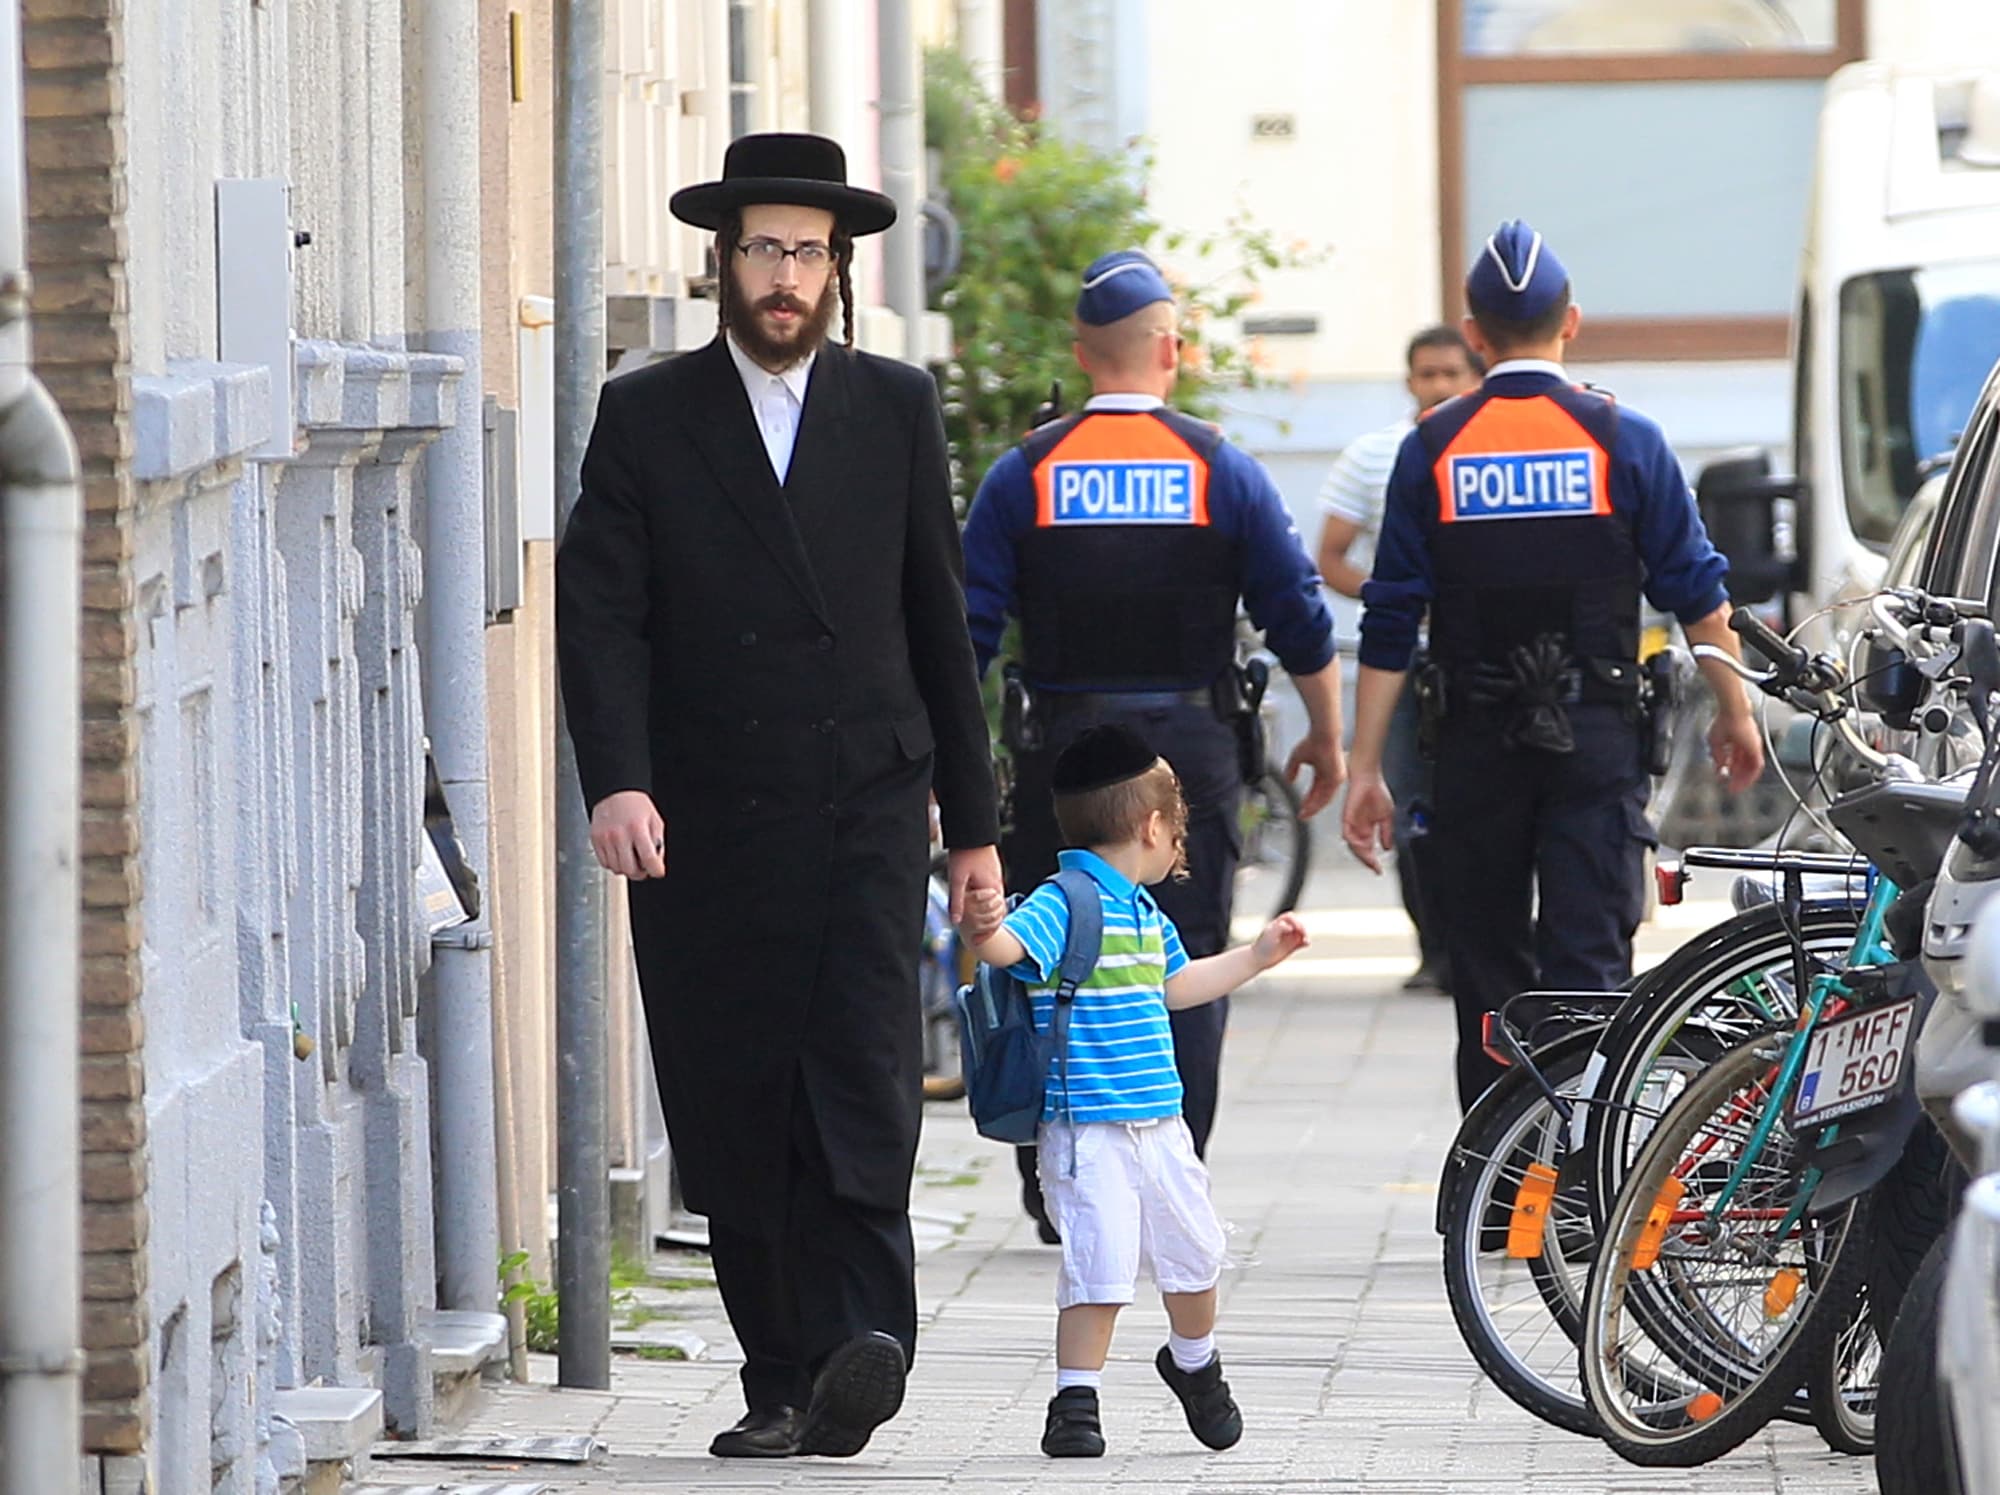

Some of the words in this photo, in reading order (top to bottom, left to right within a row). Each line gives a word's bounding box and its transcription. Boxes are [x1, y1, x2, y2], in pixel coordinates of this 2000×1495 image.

[1060, 468, 1185, 514] POLITIE
[1458, 459, 1588, 508] POLITIE
[1839, 1048, 1899, 1098] 560
